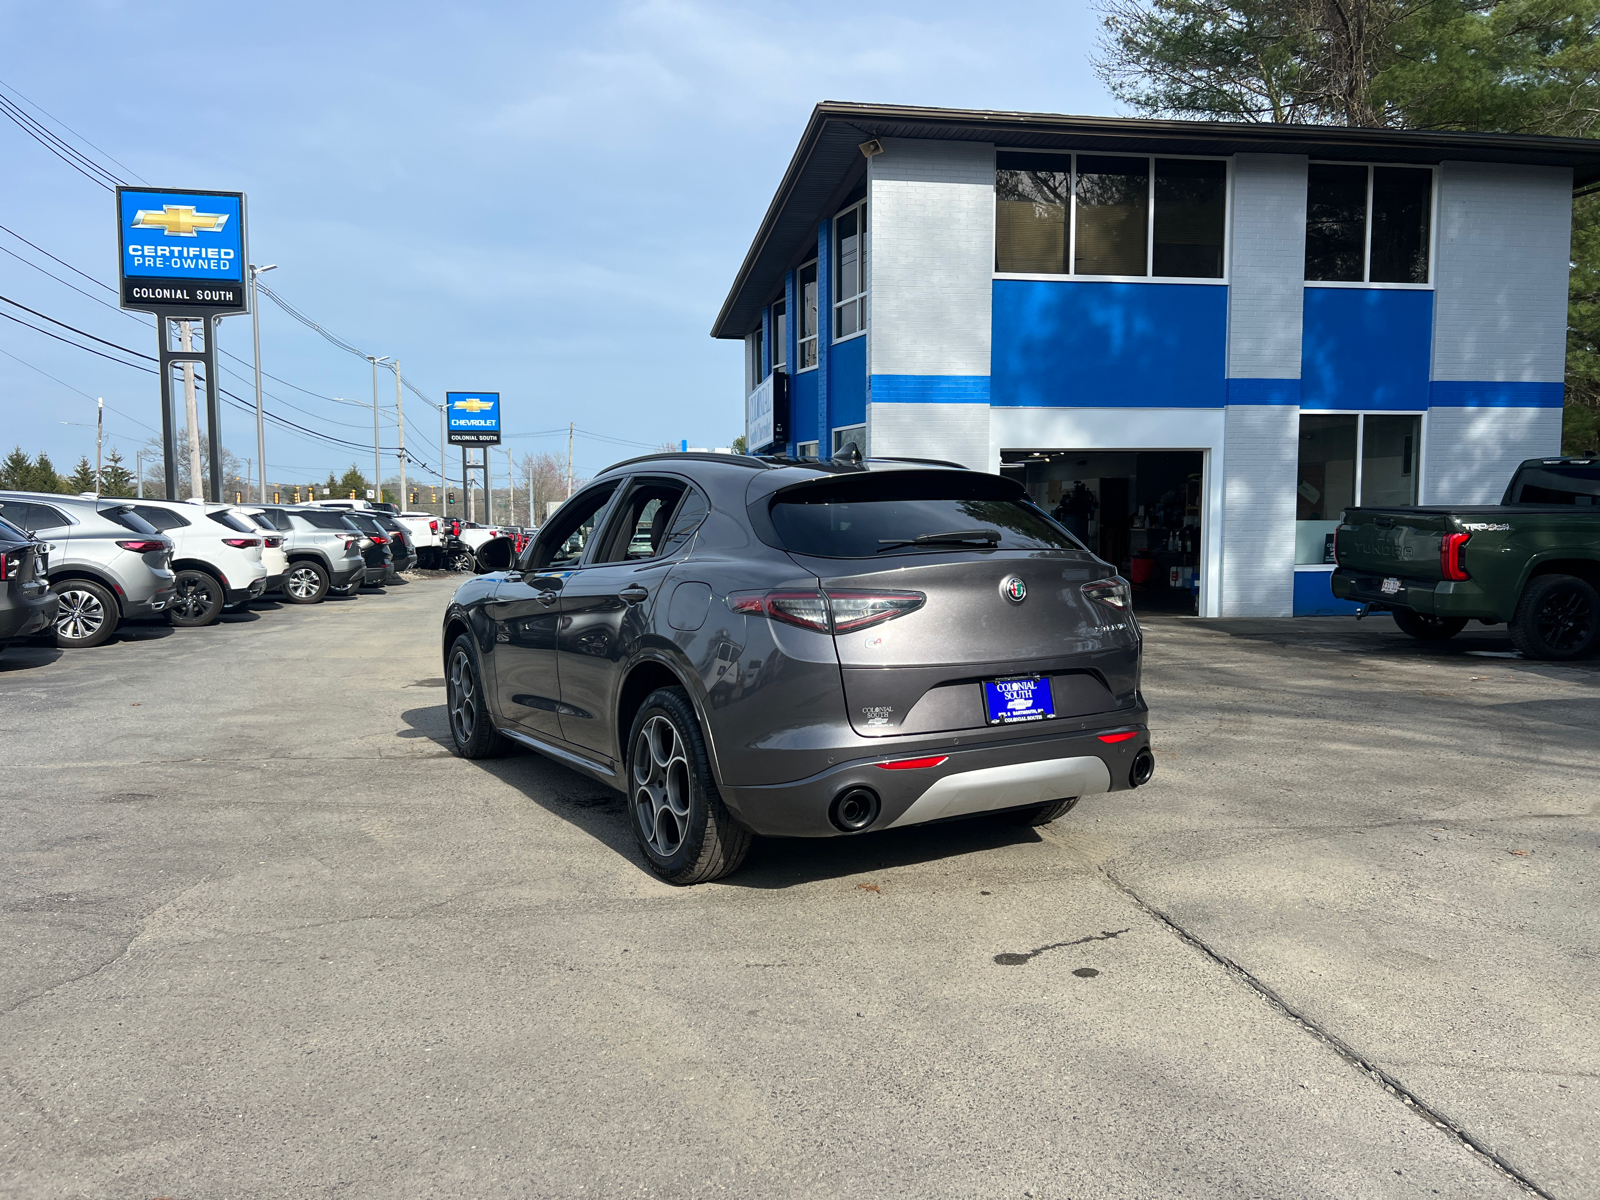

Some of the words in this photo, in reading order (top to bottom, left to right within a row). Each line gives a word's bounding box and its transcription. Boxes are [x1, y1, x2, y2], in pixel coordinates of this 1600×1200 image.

[128, 244, 235, 259] CERTIFIED
[134, 256, 230, 270] PRE-OWNED
[133, 287, 190, 299] COLONIAL
[196, 290, 233, 301] SOUTH
[1354, 541, 1414, 558] TUNDRA
[997, 681, 1038, 693] COLONIAL
[1004, 689, 1033, 700] SOUTH
[862, 706, 894, 714] COLONIAL
